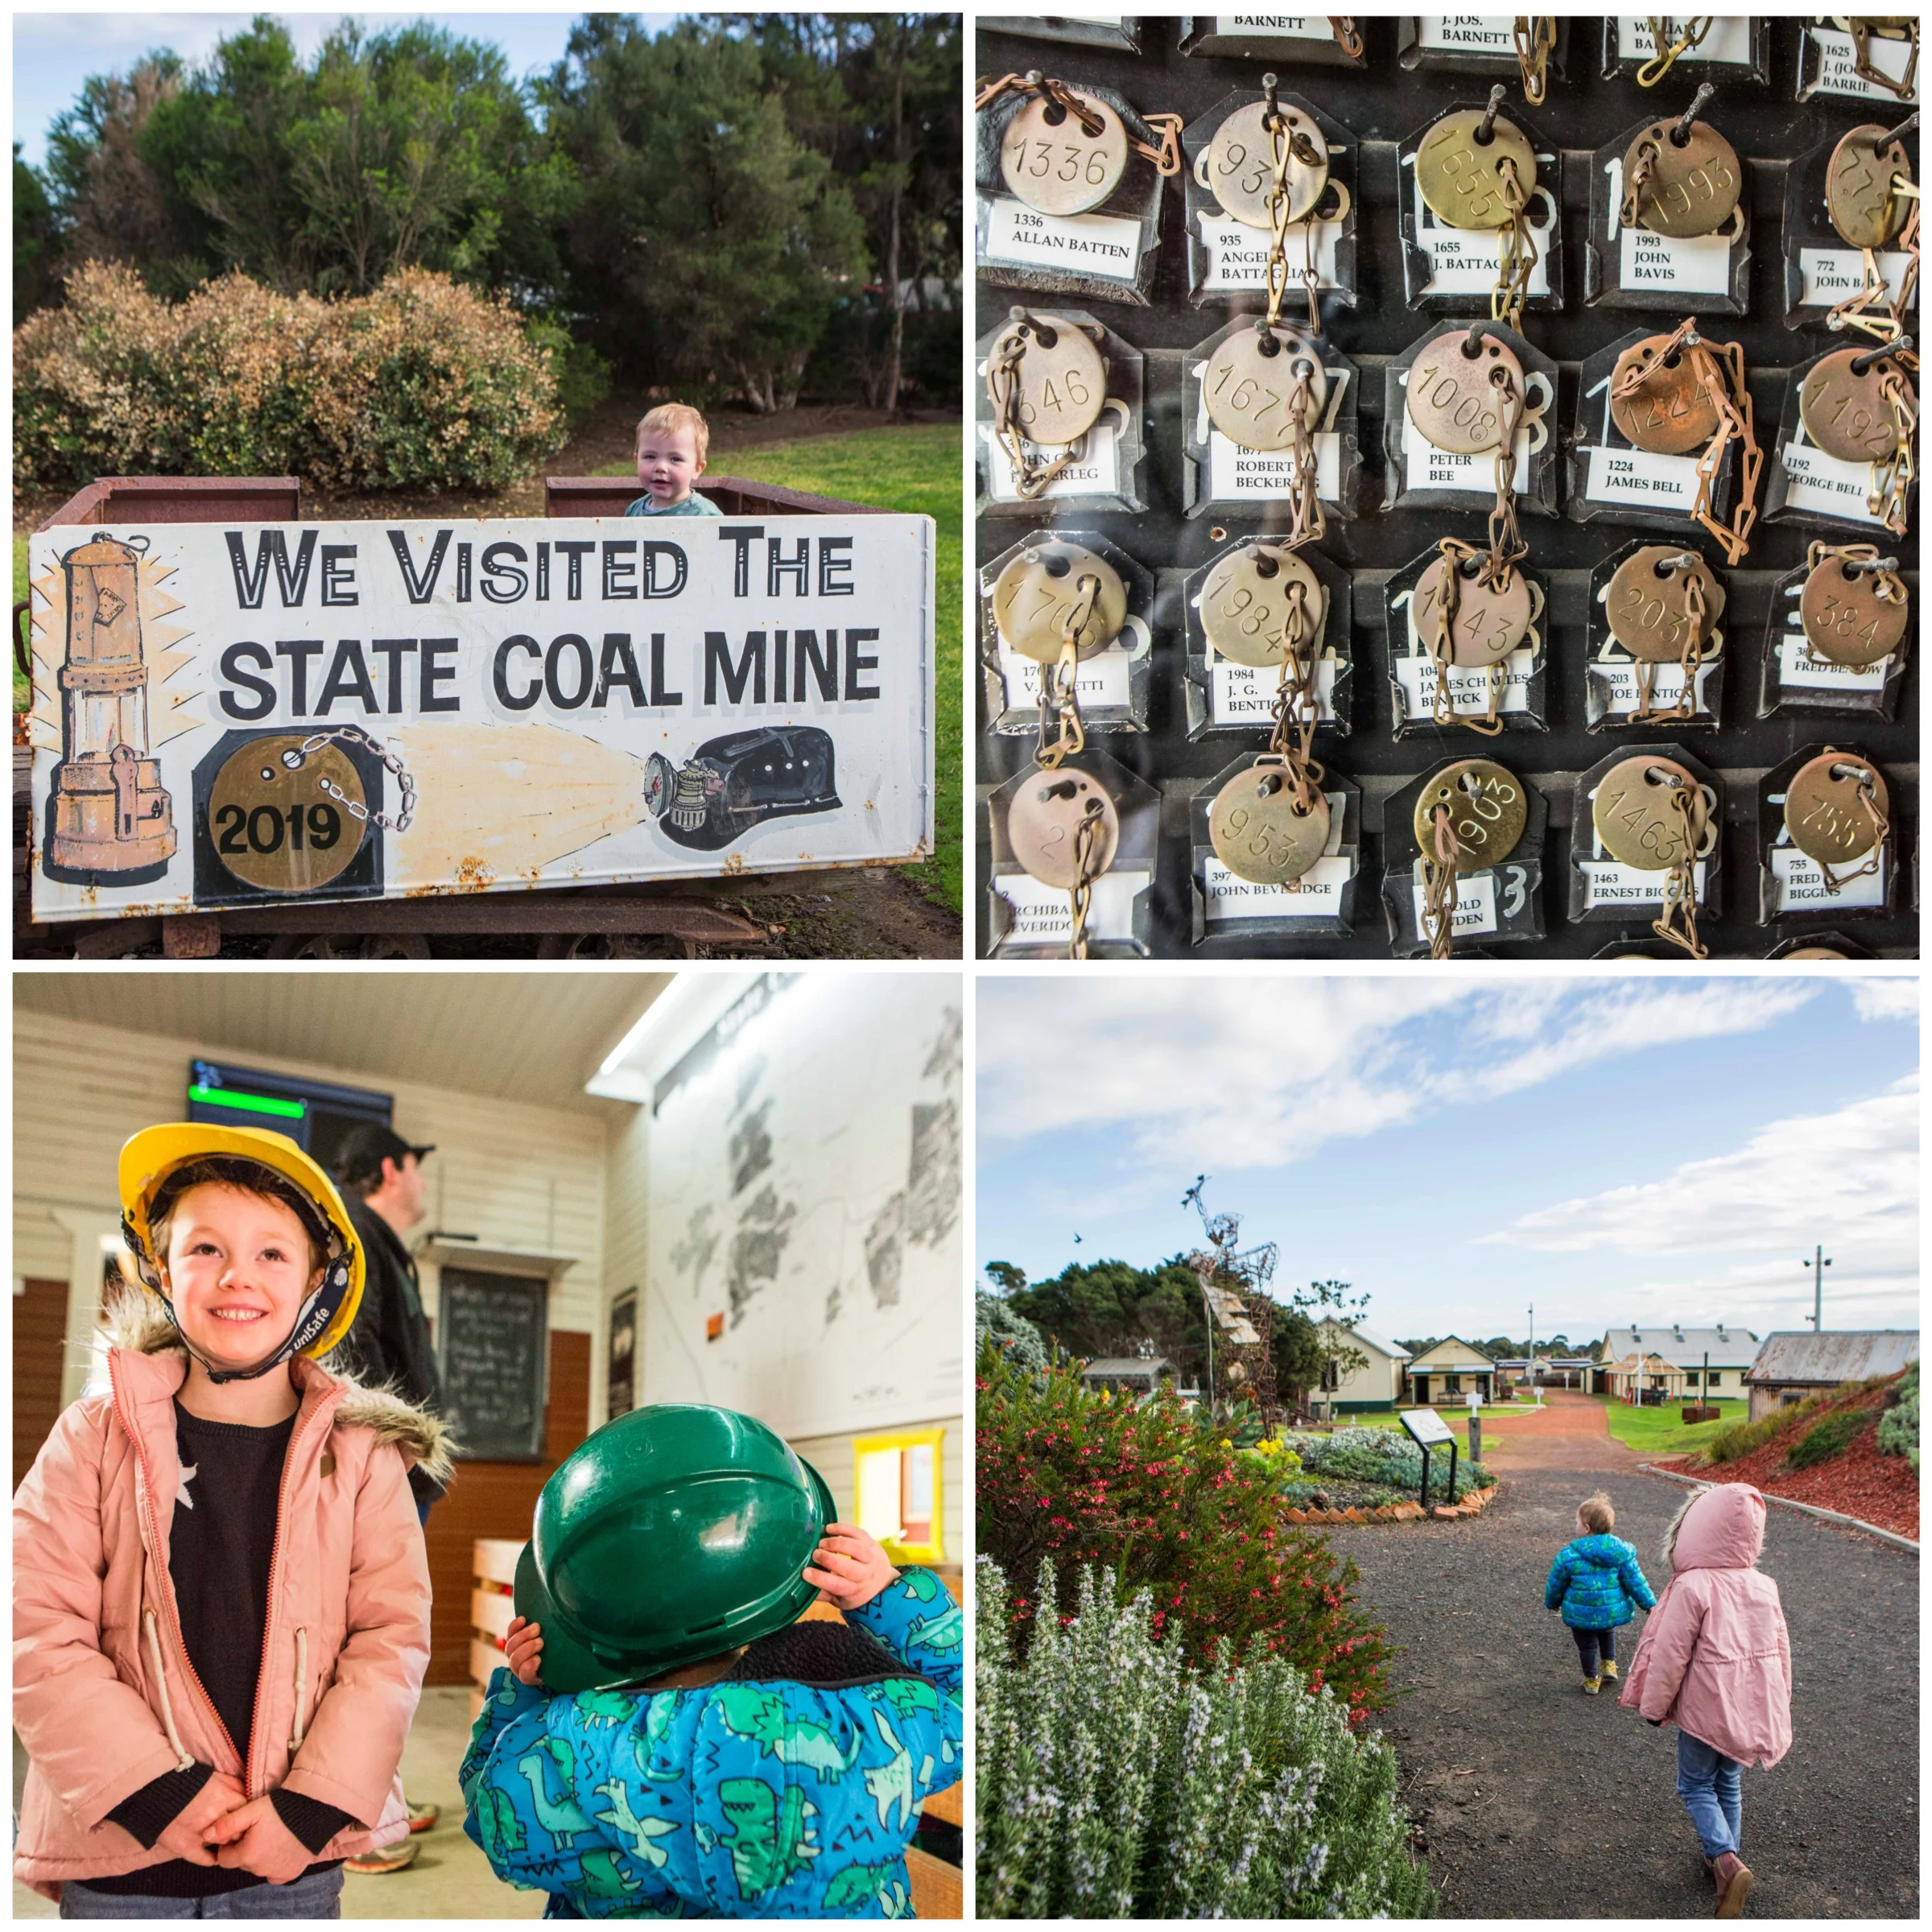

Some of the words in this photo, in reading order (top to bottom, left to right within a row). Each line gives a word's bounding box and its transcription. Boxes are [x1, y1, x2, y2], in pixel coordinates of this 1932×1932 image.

[1234, 16, 1305, 29] BARNETT
[1443, 29, 1509, 43] BARNETT
[1825, 45, 1850, 57] 1625
[1823, 60, 1831, 73] J.
[1823, 76, 1869, 93] BARRIE
[1013, 138, 1108, 185] 1336
[1430, 129, 1502, 216] 1655
[1651, 156, 1733, 223] 1993
[1013, 213, 1043, 227] 1336
[1012, 230, 1065, 248] ALLAN
[1068, 238, 1130, 258] BATTEN
[1220, 235, 1241, 246] 935
[1434, 242, 1461, 252] 1655
[1635, 236, 1661, 247] 1993
[1434, 258, 1443, 270] J.
[1634, 252, 1671, 264] JOHN
[1816, 260, 1835, 271] 772
[1634, 267, 1675, 279] BAVIS
[1815, 276, 1851, 288] JOHN
[1418, 366, 1496, 442] 1008
[1808, 381, 1893, 455] 1192
[1236, 461, 1294, 472] ROBERT
[1430, 455, 1472, 465] PETER
[1608, 460, 1633, 472] 1224
[1787, 457, 1810, 470] 1192
[1429, 470, 1455, 481] BEE
[1605, 475, 1649, 489] JAMES
[1652, 480, 1683, 493] BELL
[1836, 481, 1864, 497] BELL
[225, 529, 360, 609] WE
[386, 528, 689, 605] VISITED
[718, 525, 855, 597] THE
[1210, 574, 1286, 653] 1984
[1422, 586, 1513, 651] 143
[1618, 588, 1687, 642] 203
[1817, 595, 1879, 649] 384
[1795, 662, 1827, 672] FRED
[219, 637, 461, 720] STATE
[493, 632, 683, 711] COAL
[704, 628, 881, 705] MINE
[1227, 670, 1255, 680] 1984
[1610, 674, 1629, 683] 203
[1024, 683, 1038, 691] V.
[1228, 686, 1236, 698] J.
[1244, 685, 1258, 695] G.
[1420, 679, 1463, 694] JAES
[1609, 688, 1633, 701] JOE
[216, 802, 341, 856] 2019
[1605, 791, 1682, 861] 1463
[1222, 808, 1298, 868] 953
[1790, 860, 1807, 869] 755
[1211, 872, 1232, 881] 397
[1594, 873, 1619, 883] 1463
[1790, 873, 1820, 885] FRED
[1212, 886, 1249, 899] JOHN
[1593, 887, 1642, 898] ERNEST
